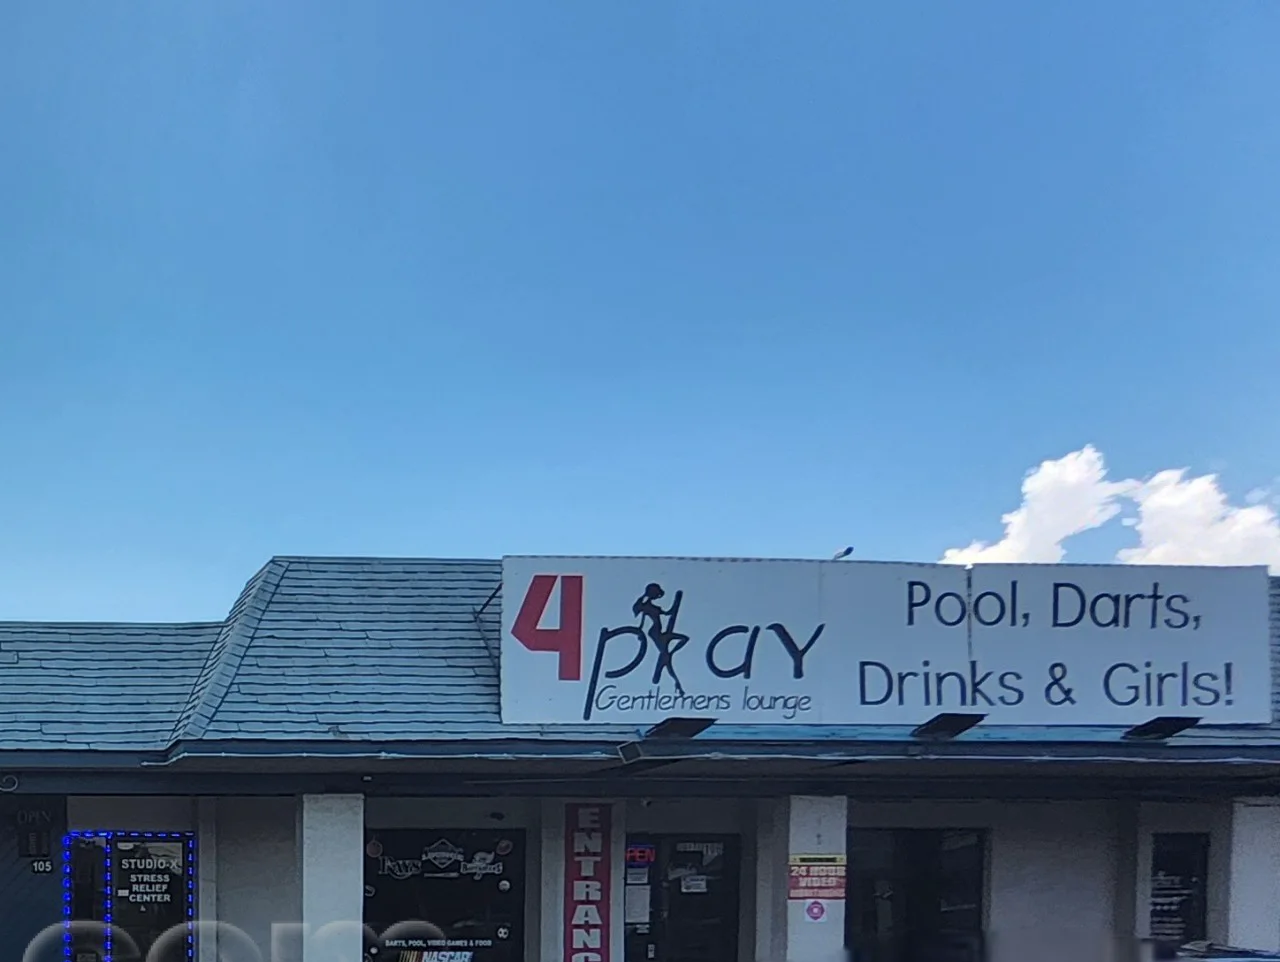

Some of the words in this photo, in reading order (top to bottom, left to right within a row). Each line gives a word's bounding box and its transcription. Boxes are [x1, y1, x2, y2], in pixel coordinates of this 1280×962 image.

[906, 580, 1030, 628] Pool,
[1051, 582, 1202, 630] Darts,
[858, 660, 1024, 707] Drinks
[1044, 662, 1077, 706] &
[1103, 661, 1234, 707] Girls!
[595, 684, 731, 712] Gentlemens
[741, 685, 812, 720] lounge
[32, 861, 52, 872] 105
[130, 874, 170, 883] STRESS
[132, 884, 168, 893] RELIEF
[129, 894, 172, 903] CENTER
[408, 939, 427, 948] POOL,
